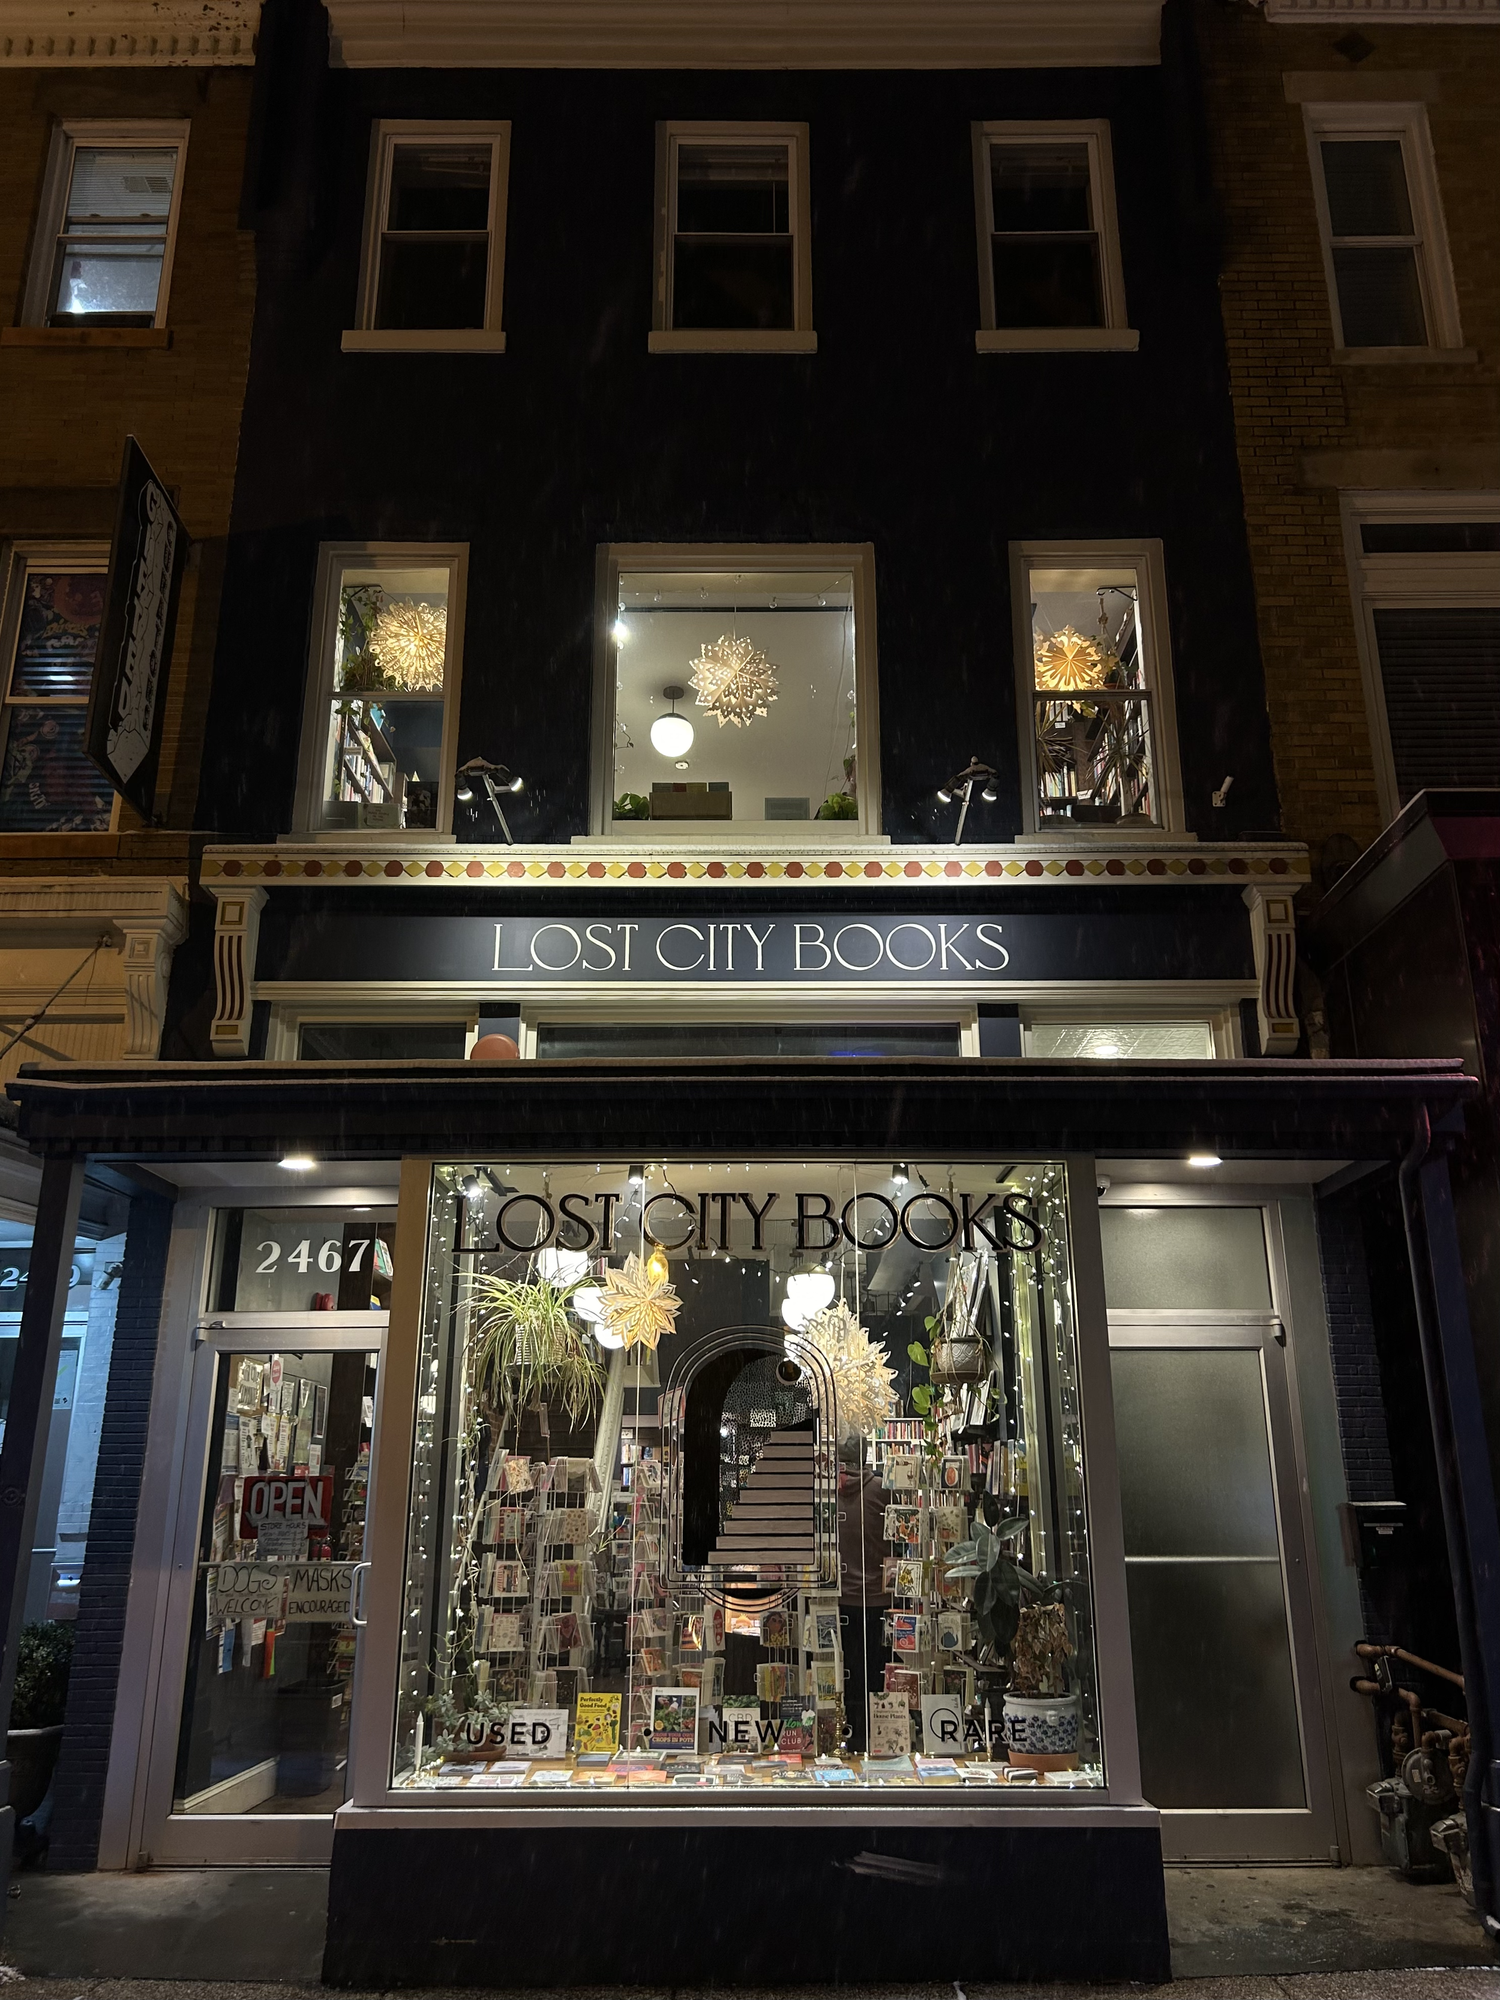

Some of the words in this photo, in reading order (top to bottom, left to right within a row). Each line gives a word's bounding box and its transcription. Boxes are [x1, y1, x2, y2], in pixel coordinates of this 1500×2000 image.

[491, 923, 639, 971] LOST
[655, 923, 776, 971] CITY
[793, 923, 1010, 971] BOOKS
[451, 1194, 621, 1253] LOST
[640, 1193, 780, 1251] CITY
[795, 1193, 1043, 1253] BOOKS
[255, 1239, 371, 1274] 2467
[250, 1481, 324, 1521] OPEN
[260, 1522, 284, 1531] STORE
[285, 1521, 307, 1530] HOURS
[218, 1564, 279, 1594] DOGS
[292, 1567, 352, 1593] MASKS
[288, 1599, 351, 1615] ENCOURAGED
[466, 1722, 552, 1745] USED
[708, 1720, 786, 1743] NEW
[940, 1720, 1028, 1742] RARE
[780, 1737, 802, 1745] CLUB
